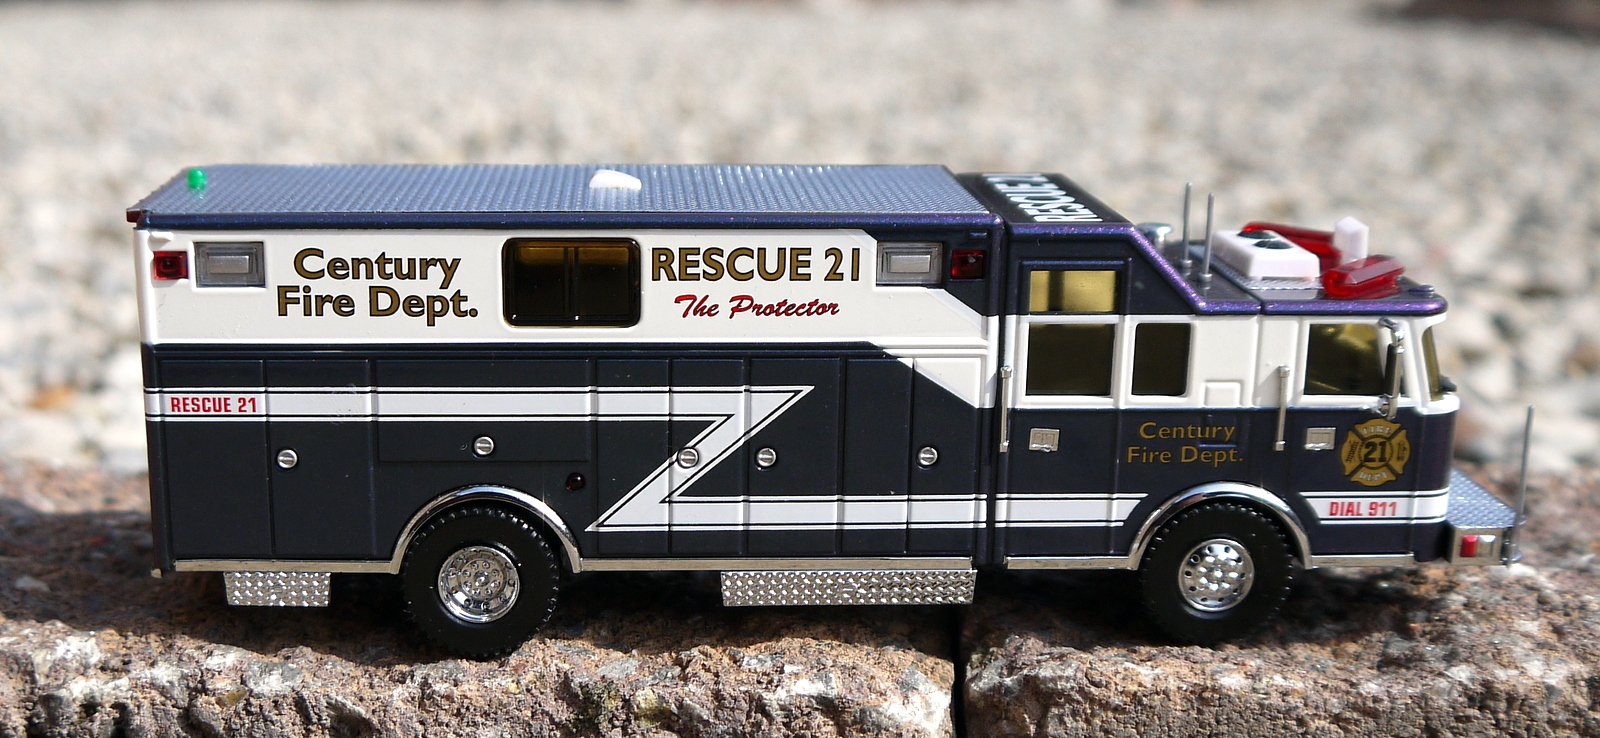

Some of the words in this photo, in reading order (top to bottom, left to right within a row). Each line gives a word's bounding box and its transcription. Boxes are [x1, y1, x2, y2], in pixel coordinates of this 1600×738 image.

[994, 183, 1103, 222] RESCUE
[294, 247, 461, 289] Century
[651, 247, 812, 281] RESCUE
[824, 248, 861, 281] 21
[277, 285, 355, 317] Fire
[369, 285, 479, 327] Dept.
[674, 294, 720, 318] The
[729, 294, 839, 319] Protector
[170, 396, 232, 413] RESCUE
[237, 397, 257, 413] 21
[1139, 421, 1236, 442] Century
[1127, 446, 1172, 463] Fire
[1181, 445, 1244, 468] Dept.
[1363, 441, 1388, 463] 21
[1328, 501, 1363, 517] DIAL
[1368, 501, 1398, 517] 911
